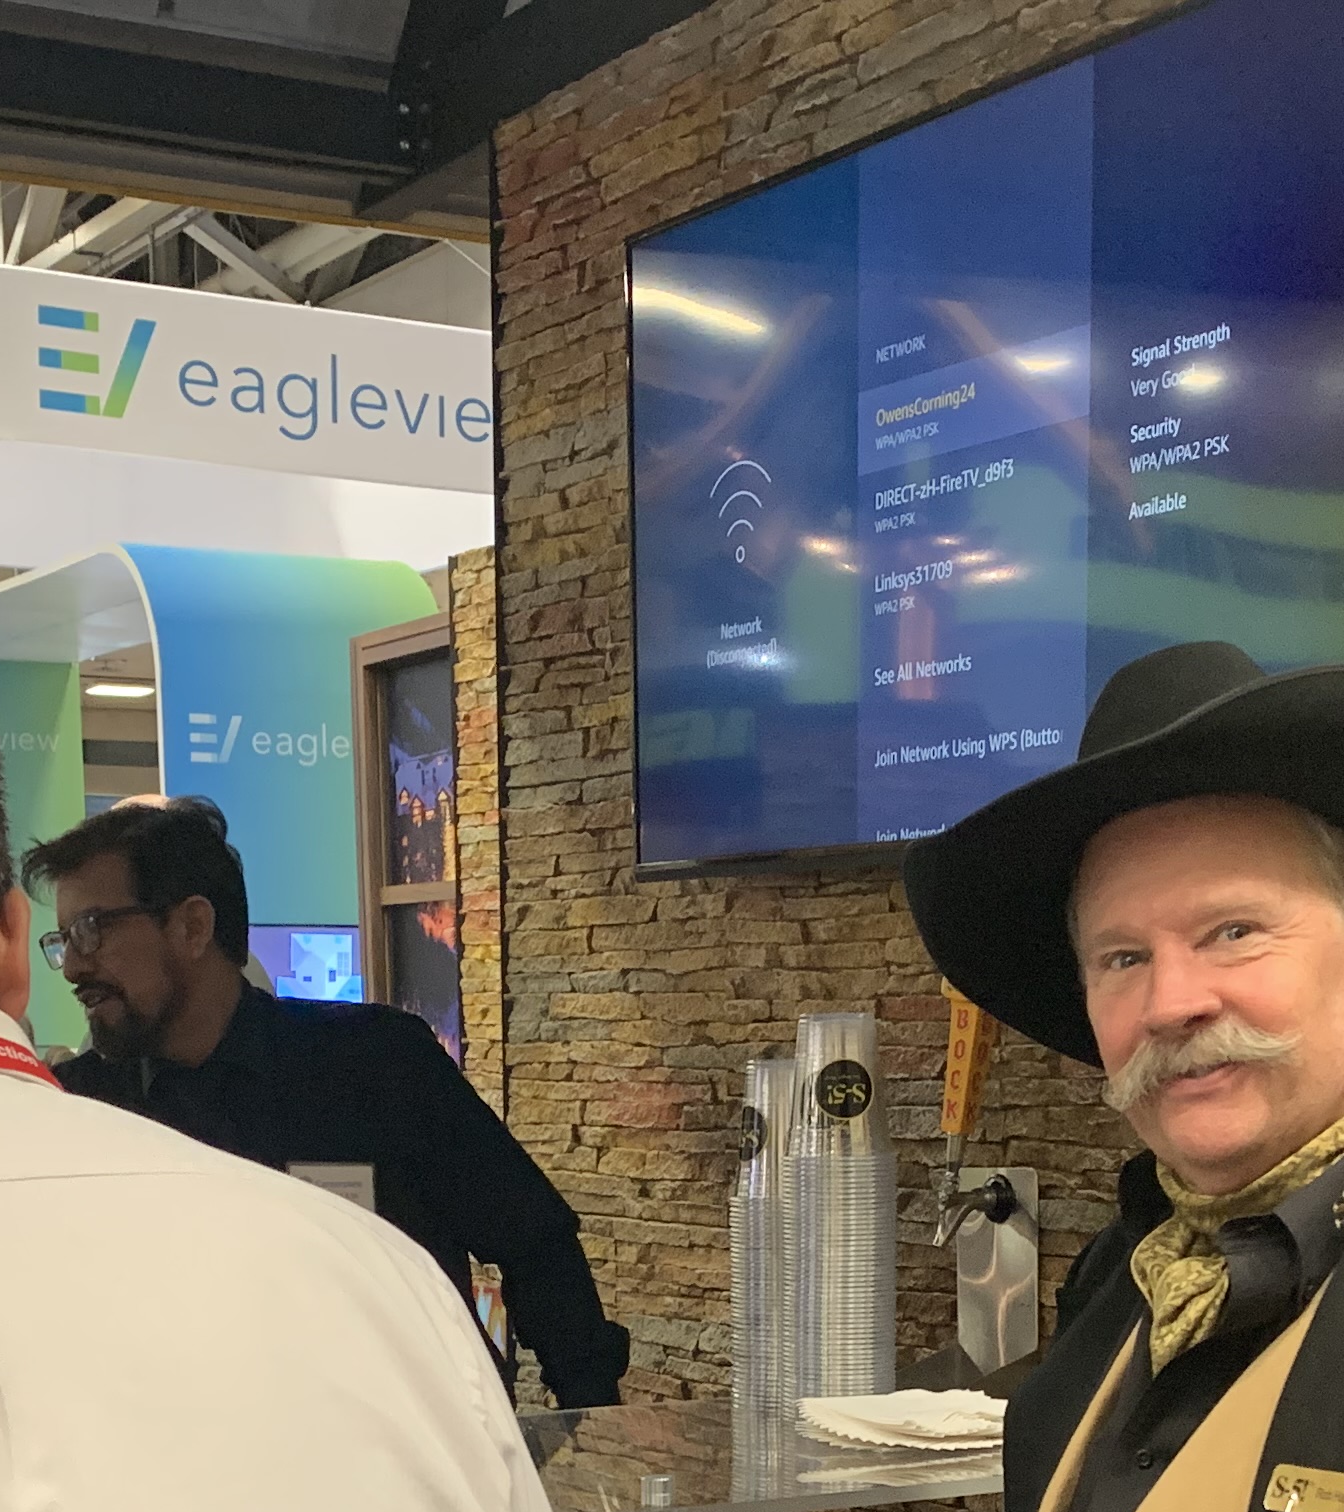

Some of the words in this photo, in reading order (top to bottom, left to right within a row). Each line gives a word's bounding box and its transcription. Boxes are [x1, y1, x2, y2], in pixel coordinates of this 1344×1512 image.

[876, 334, 926, 364] NETWORK
[1131, 338, 1170, 367] Signal
[1174, 322, 1231, 354] Strength
[178, 353, 492, 444] eaglevie
[876, 382, 975, 427] OwensCorning24
[1131, 379, 1158, 397] Very
[875, 425, 922, 450] WPA/WPA2
[923, 422, 940, 438] PSK
[1130, 417, 1181, 444] Security
[1130, 441, 1200, 474] WPA/WPA2
[1204, 434, 1230, 457] PSK
[874, 516, 899, 533] WPA2
[900, 512, 916, 527] PSK
[1129, 492, 1187, 520] Available
[875, 560, 953, 593] Linksys31709
[874, 600, 898, 616] WPA2
[899, 596, 915, 611] PSK
[720, 616, 762, 640] Network
[874, 668, 895, 687] See
[897, 662, 913, 681] All
[915, 653, 972, 678] Networks
[252, 723, 350, 766] eagle
[874, 750, 898, 768] Join
[901, 740, 949, 763] Network
[953, 738, 986, 759] Using
[989, 731, 1017, 752] WPS
[1021, 728, 1063, 751] (Butto
[946, 1009, 969, 1119] BOCK
